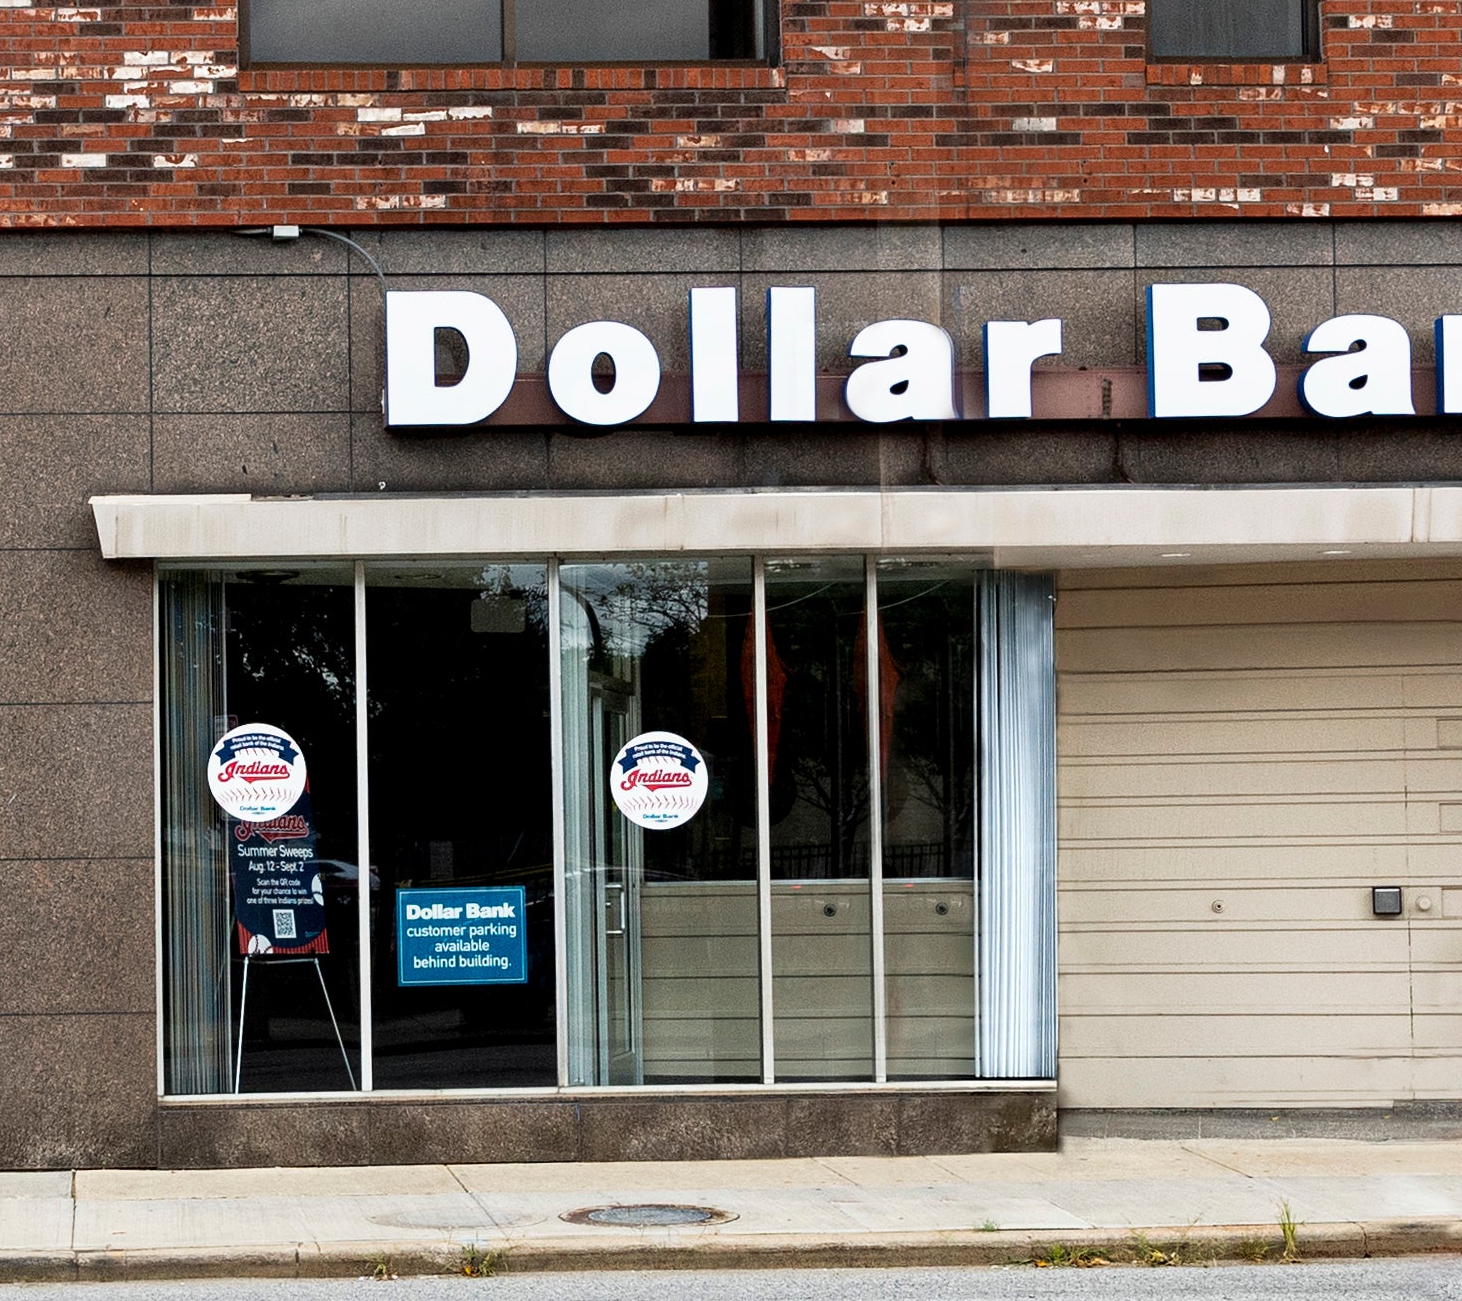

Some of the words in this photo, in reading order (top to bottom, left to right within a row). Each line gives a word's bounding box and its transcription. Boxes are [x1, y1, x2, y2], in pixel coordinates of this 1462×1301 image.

[384, 284, 1064, 428] Dollar
[217, 760, 291, 784] Indians
[620, 768, 692, 792] Indians
[237, 844, 278, 857] Summer
[279, 845, 314, 861] Sweeps
[248, 860, 265, 874] Aug.
[266, 861, 275, 872] 12
[280, 861, 298, 874] Sept.
[299, 861, 304, 872] 2
[406, 903, 463, 920] Dollar
[465, 902, 516, 919] Bank
[406, 925, 467, 938] customer
[469, 923, 517, 939] parking
[434, 939, 490, 952] available
[413, 955, 456, 969] behind
[459, 954, 512, 970] building.
